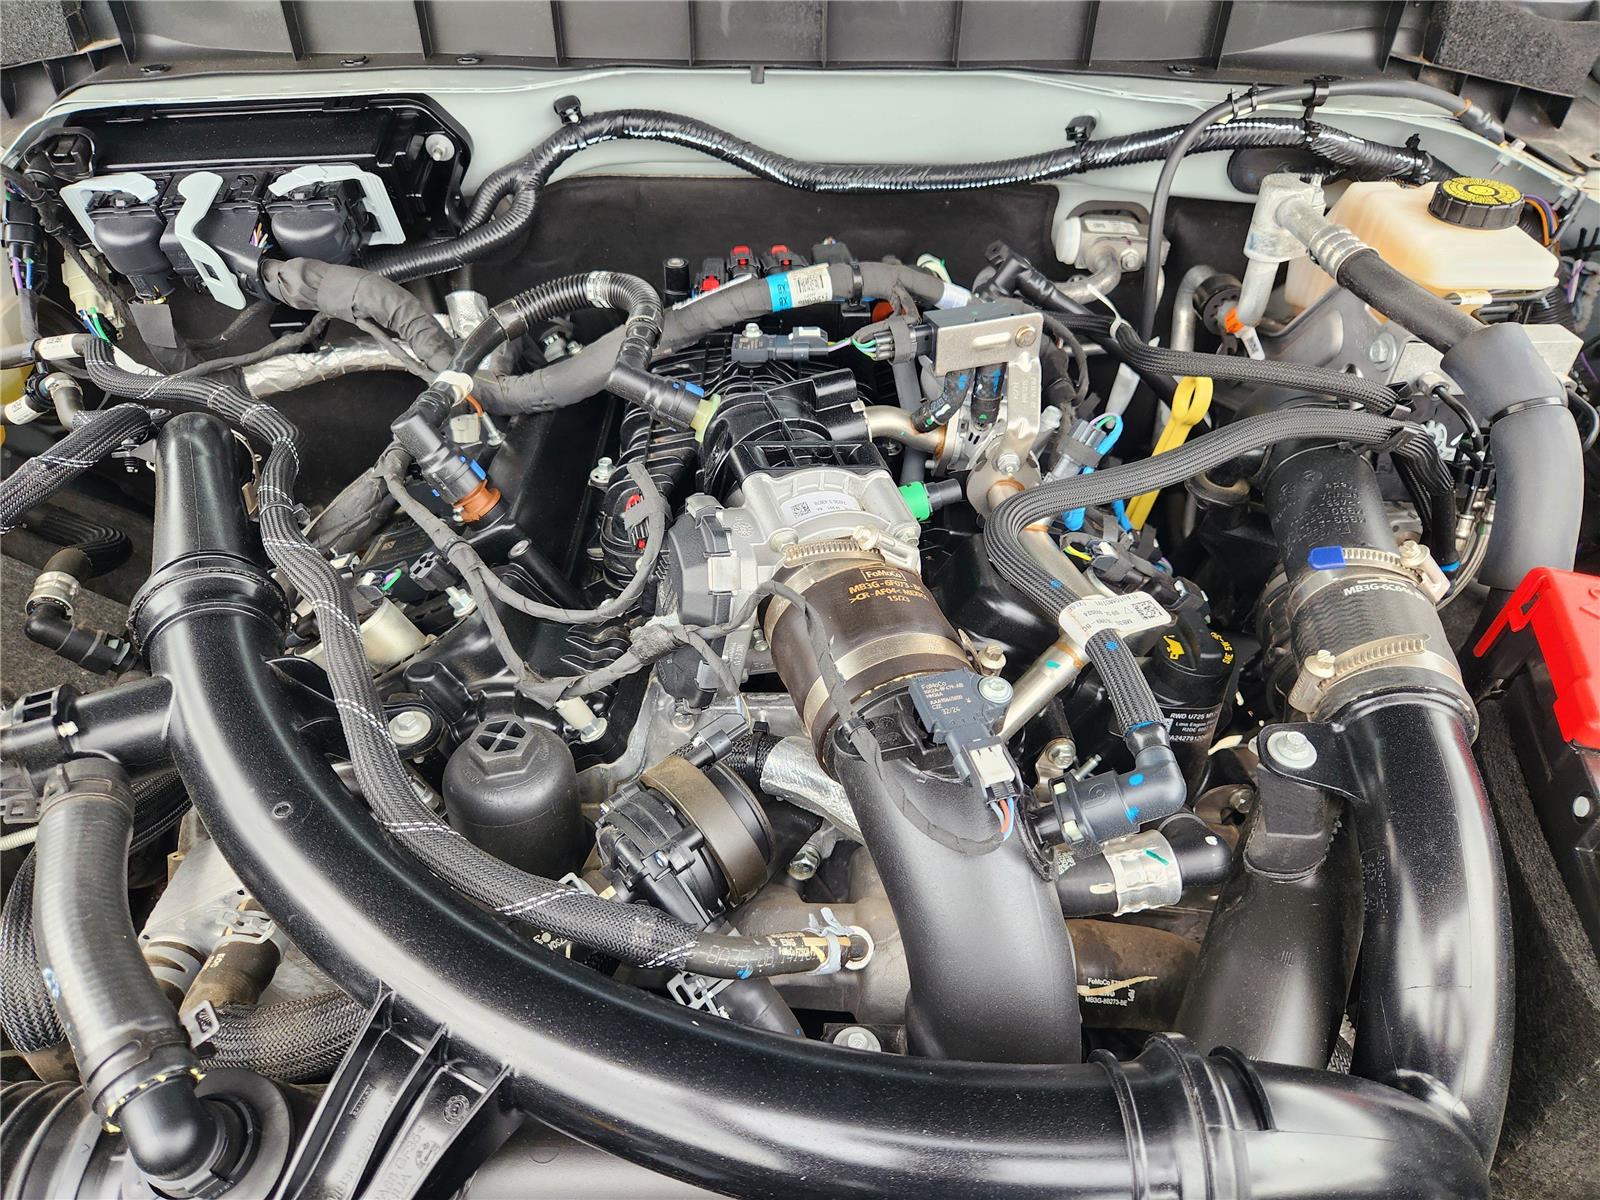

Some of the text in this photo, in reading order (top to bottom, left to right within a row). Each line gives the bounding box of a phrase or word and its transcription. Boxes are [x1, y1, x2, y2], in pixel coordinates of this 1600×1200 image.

[865, 570, 902, 578] FoMoCo
[921, 681, 947, 690] FoMoCo
[1088, 977, 1111, 986] FoMoCo
